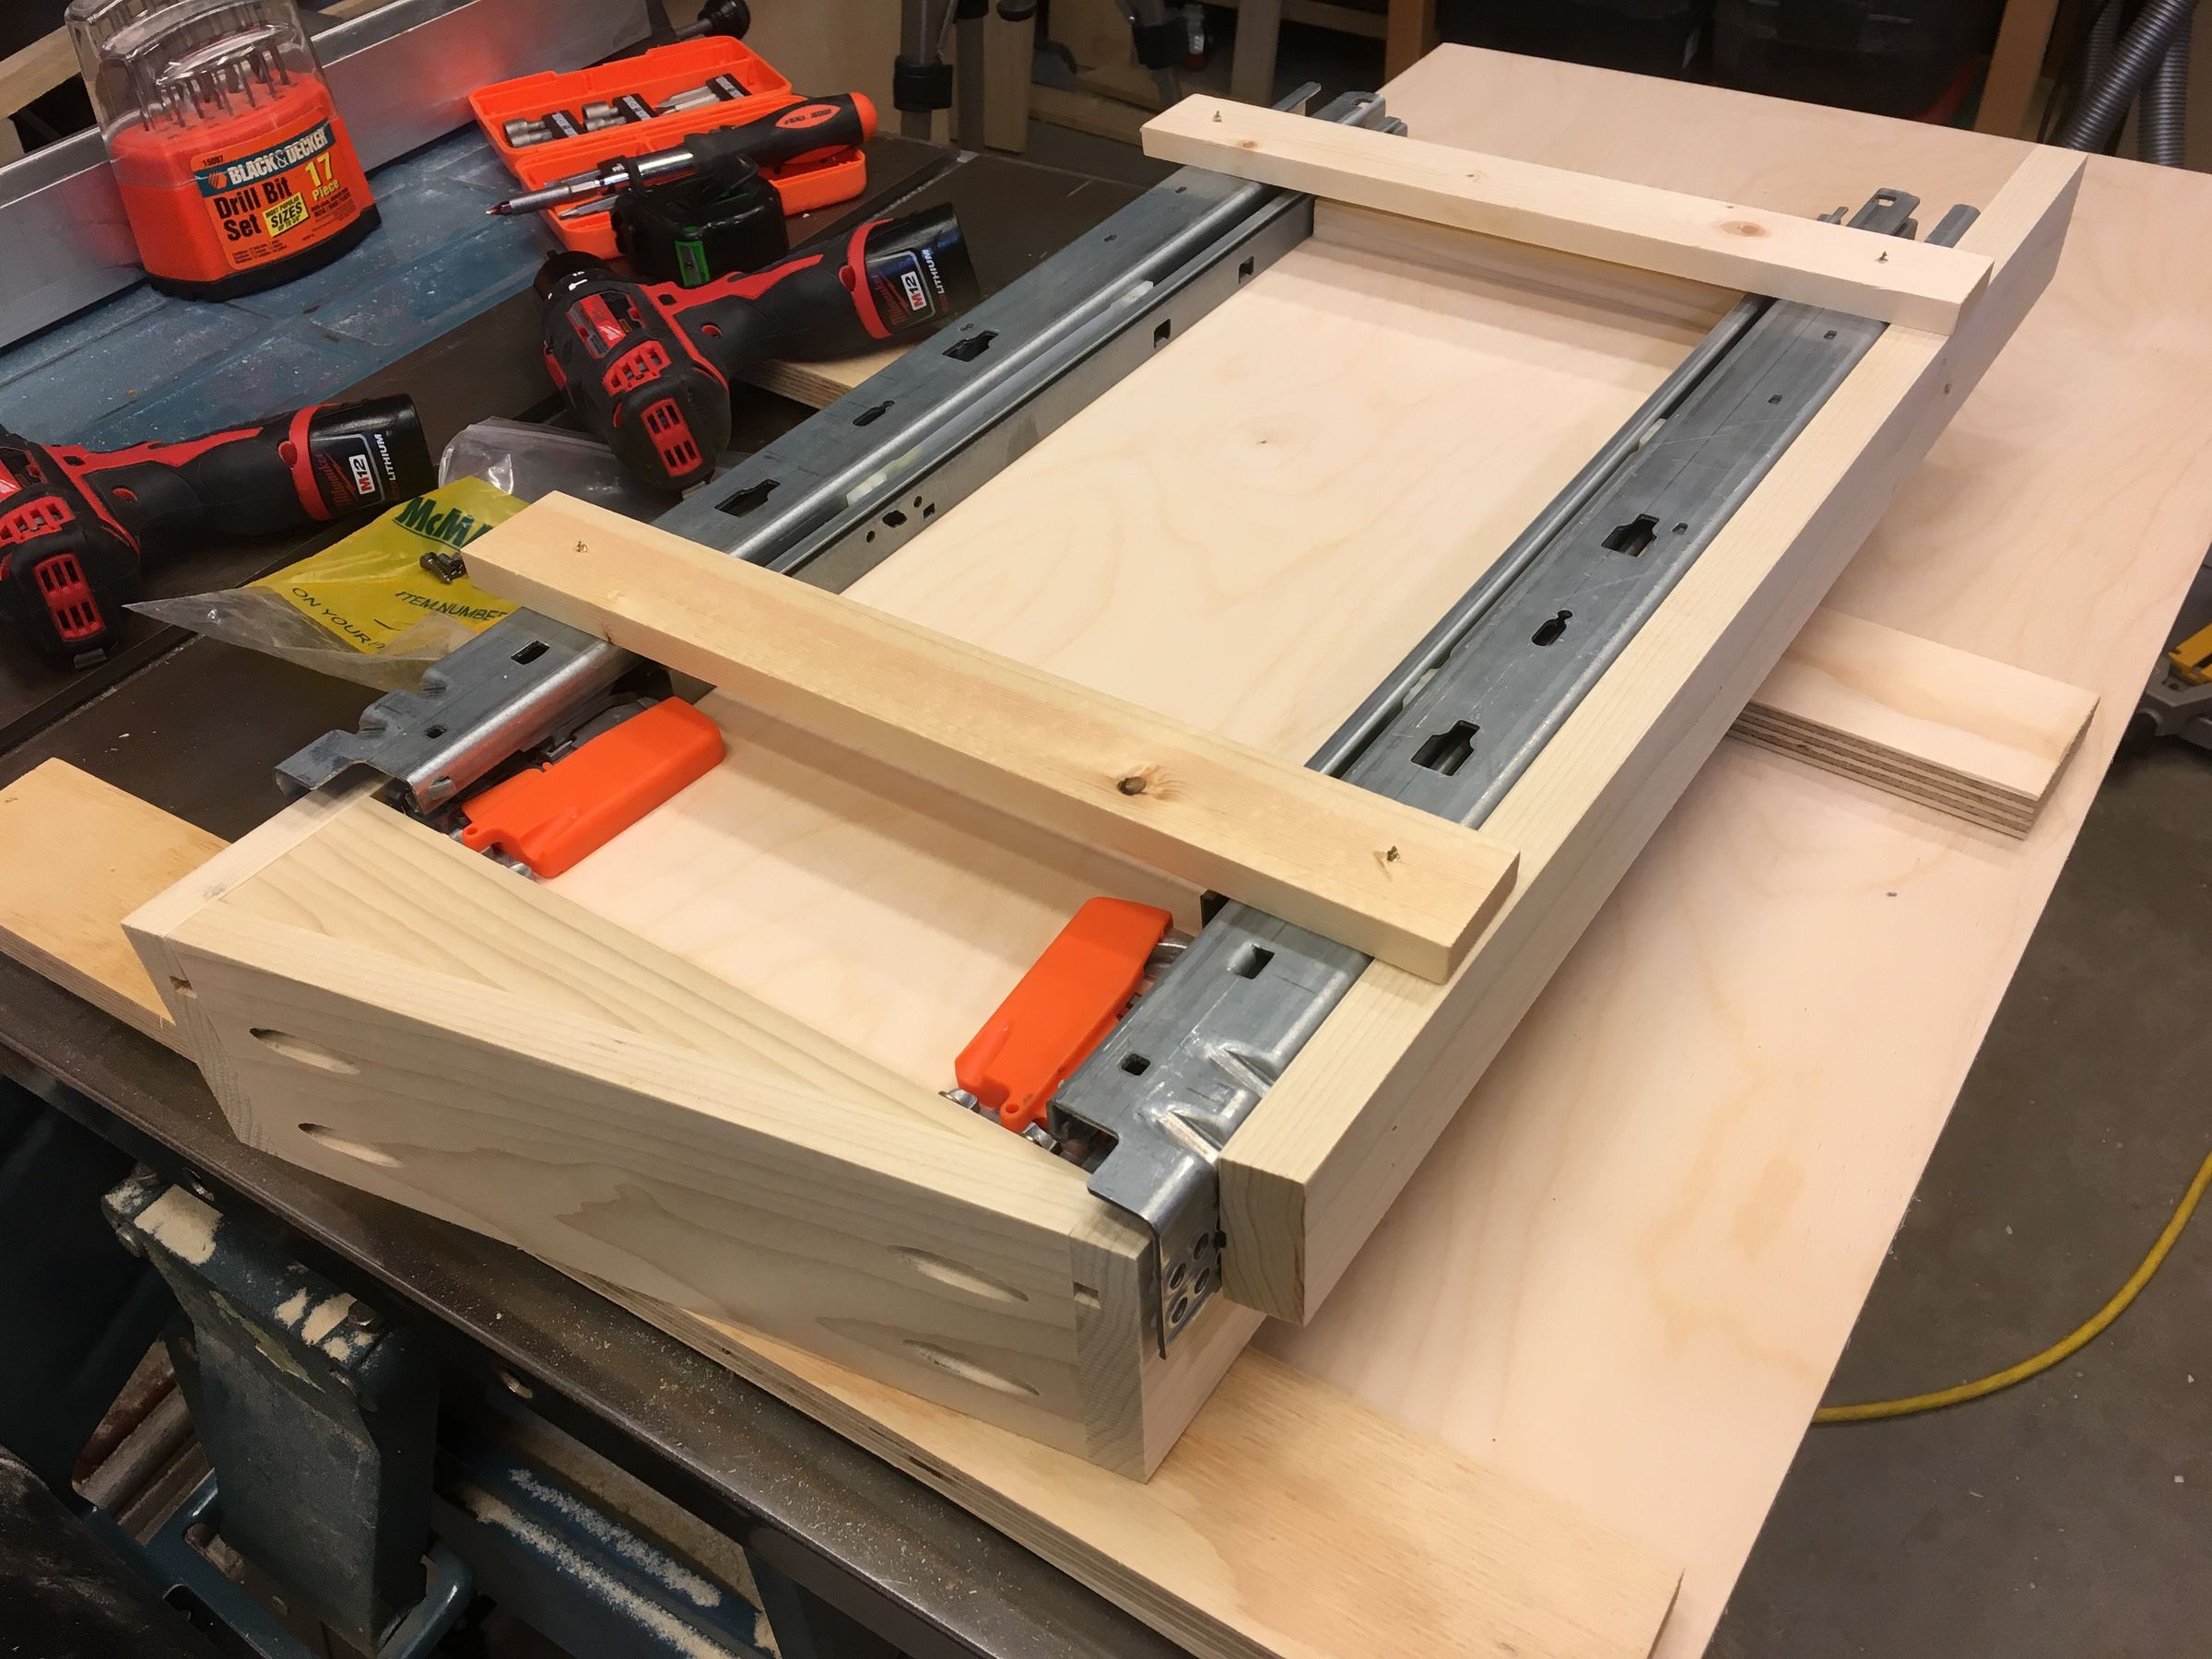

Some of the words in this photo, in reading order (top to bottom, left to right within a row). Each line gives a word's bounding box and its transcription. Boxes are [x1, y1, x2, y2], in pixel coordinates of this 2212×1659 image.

[305, 152, 335, 187] 17
[213, 187, 262, 219] Drill
[262, 176, 292, 205] Bit
[312, 180, 340, 201] Piece
[223, 213, 262, 241] Set
[270, 202, 302, 229] SIZES
[904, 276, 924, 308] M12
[353, 458, 372, 491] M12
[292, 587, 322, 606] ON
[321, 608, 371, 643] YOUR
[394, 591, 440, 610] ITEM
